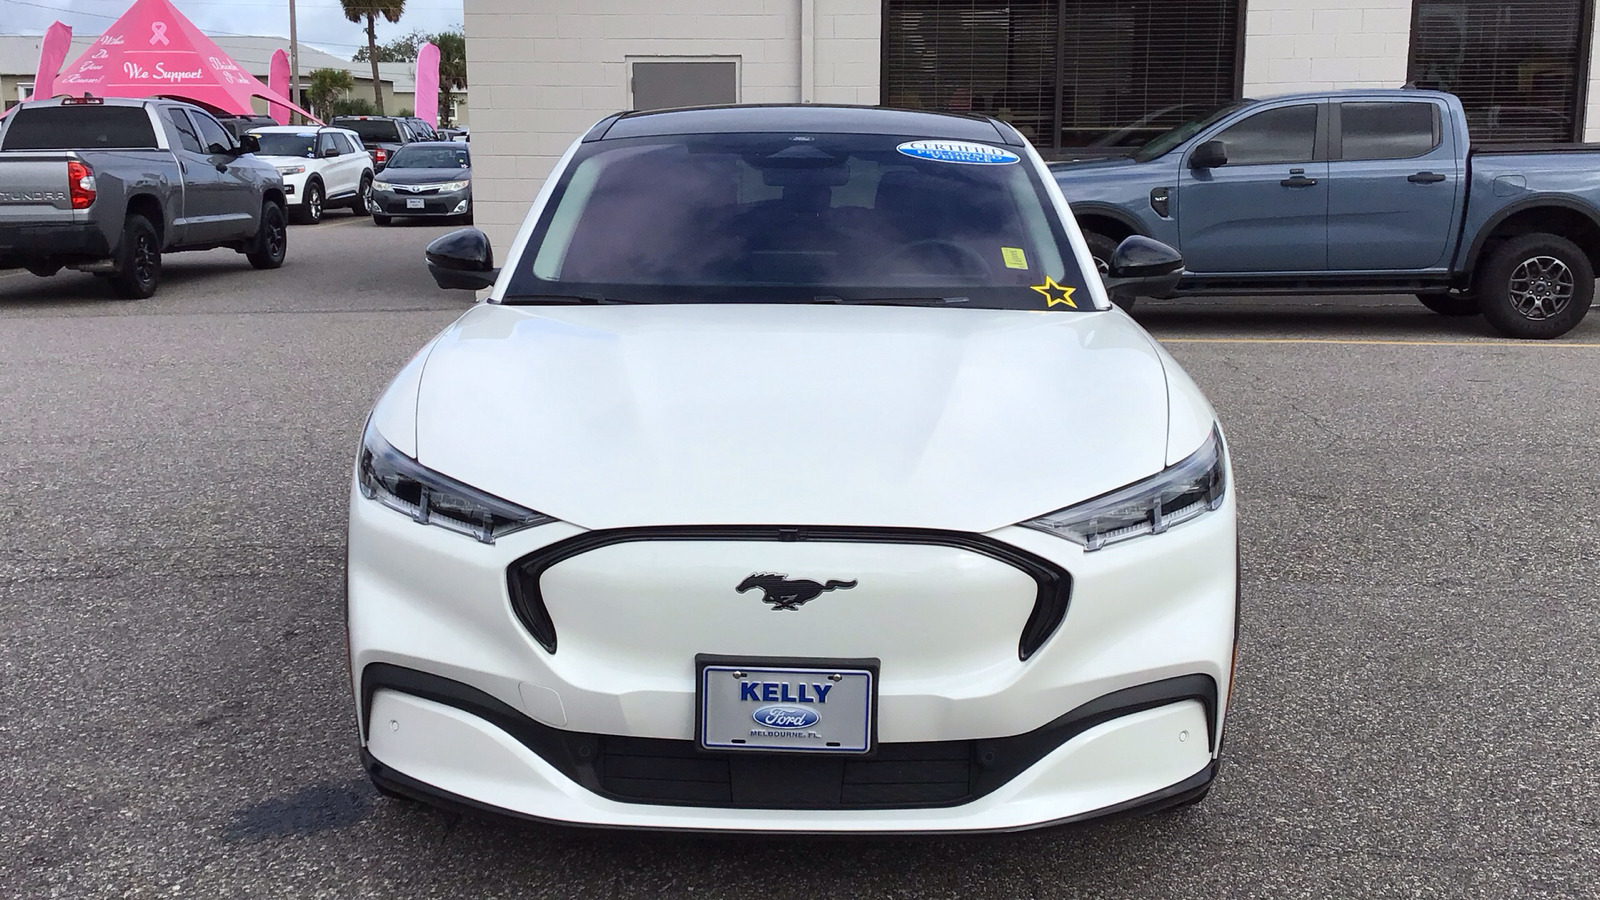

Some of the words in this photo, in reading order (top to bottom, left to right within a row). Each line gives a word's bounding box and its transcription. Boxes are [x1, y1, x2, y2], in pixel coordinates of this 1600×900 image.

[209, 56, 238, 70] Think
[123, 61, 149, 79] We
[152, 62, 203, 82] Support
[910, 142, 1005, 156] CERTIFIED
[0, 191, 66, 201] TUNDRA
[740, 681, 833, 704] KELLY
[765, 706, 807, 727] Ford
[750, 730, 806, 738] MELBOURNE,
